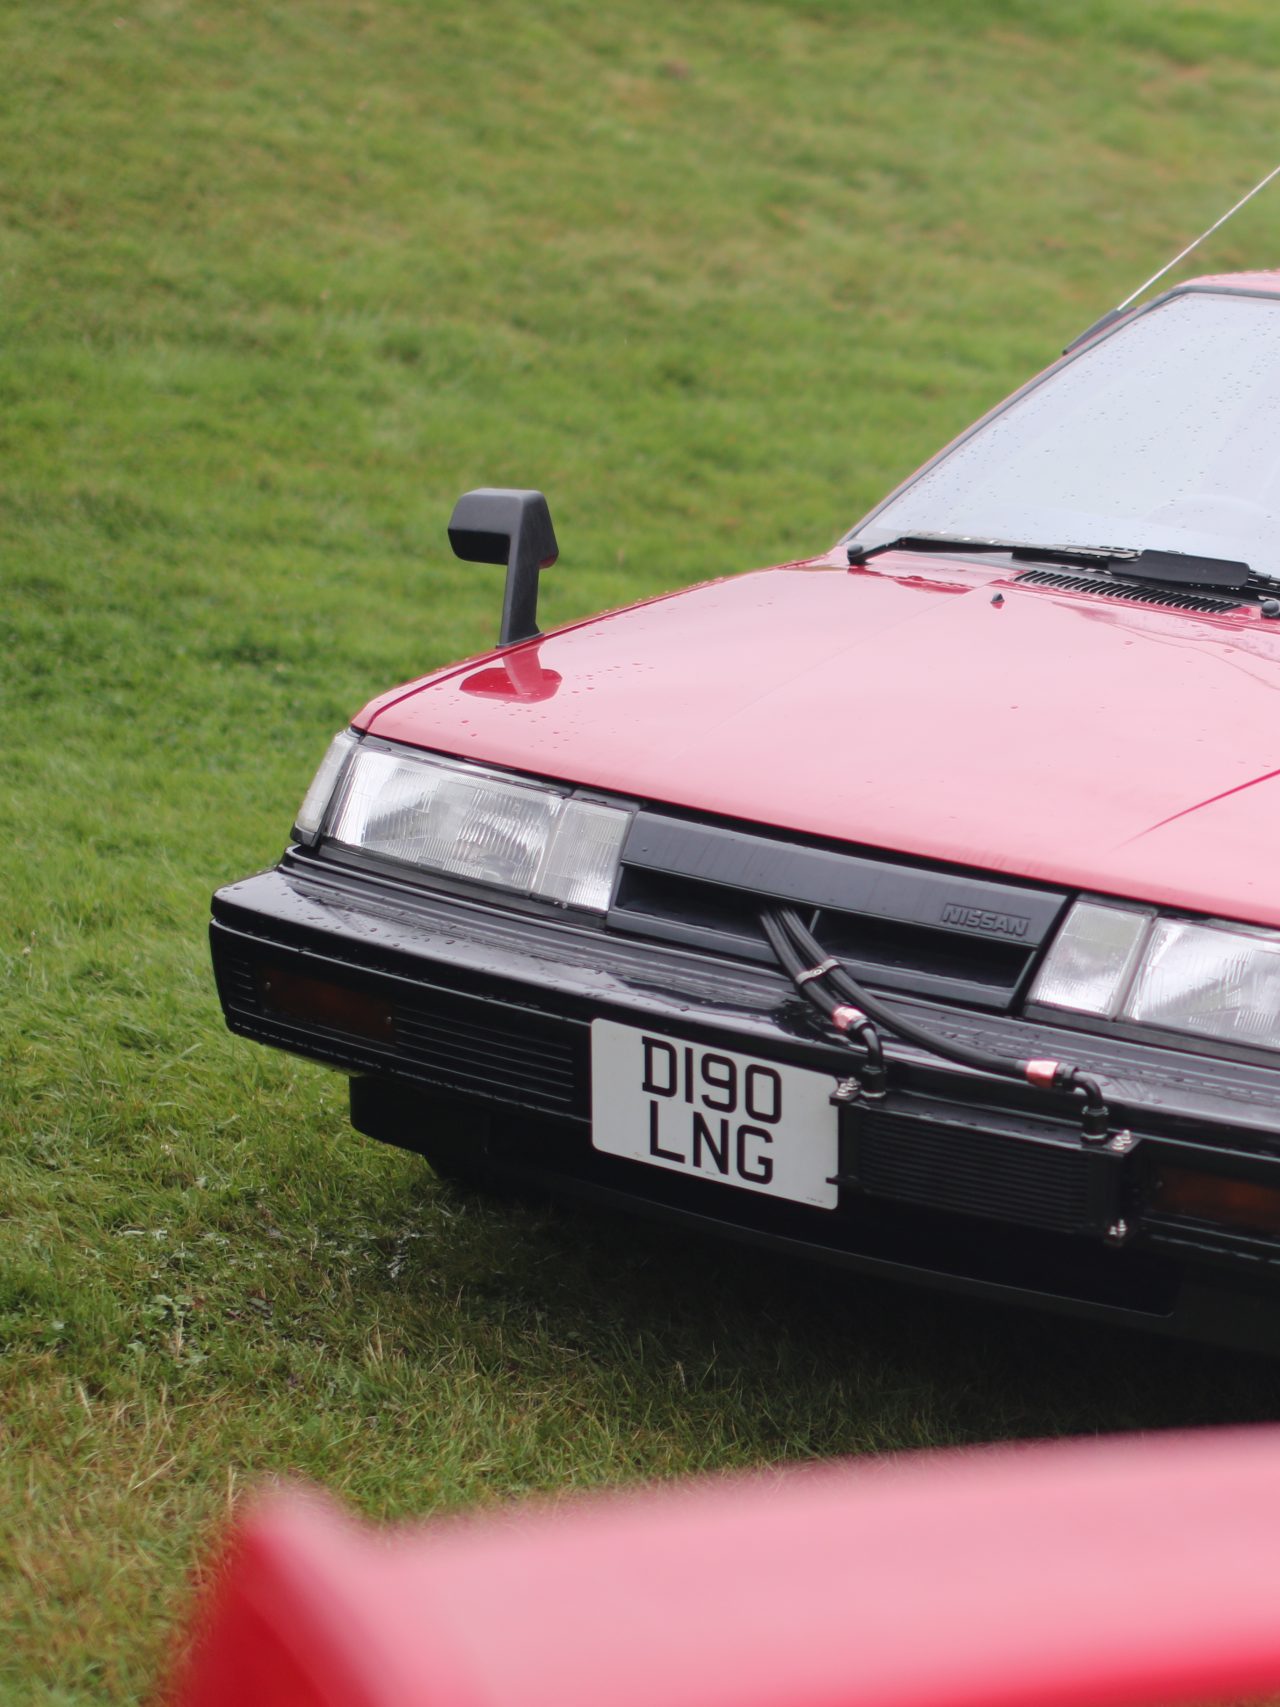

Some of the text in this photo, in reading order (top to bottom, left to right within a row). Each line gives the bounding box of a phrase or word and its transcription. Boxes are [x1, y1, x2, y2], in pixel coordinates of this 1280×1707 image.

[942, 904, 1029, 937] NISSAN
[642, 1035, 782, 1125] D190
[650, 1099, 773, 1185] LNG
